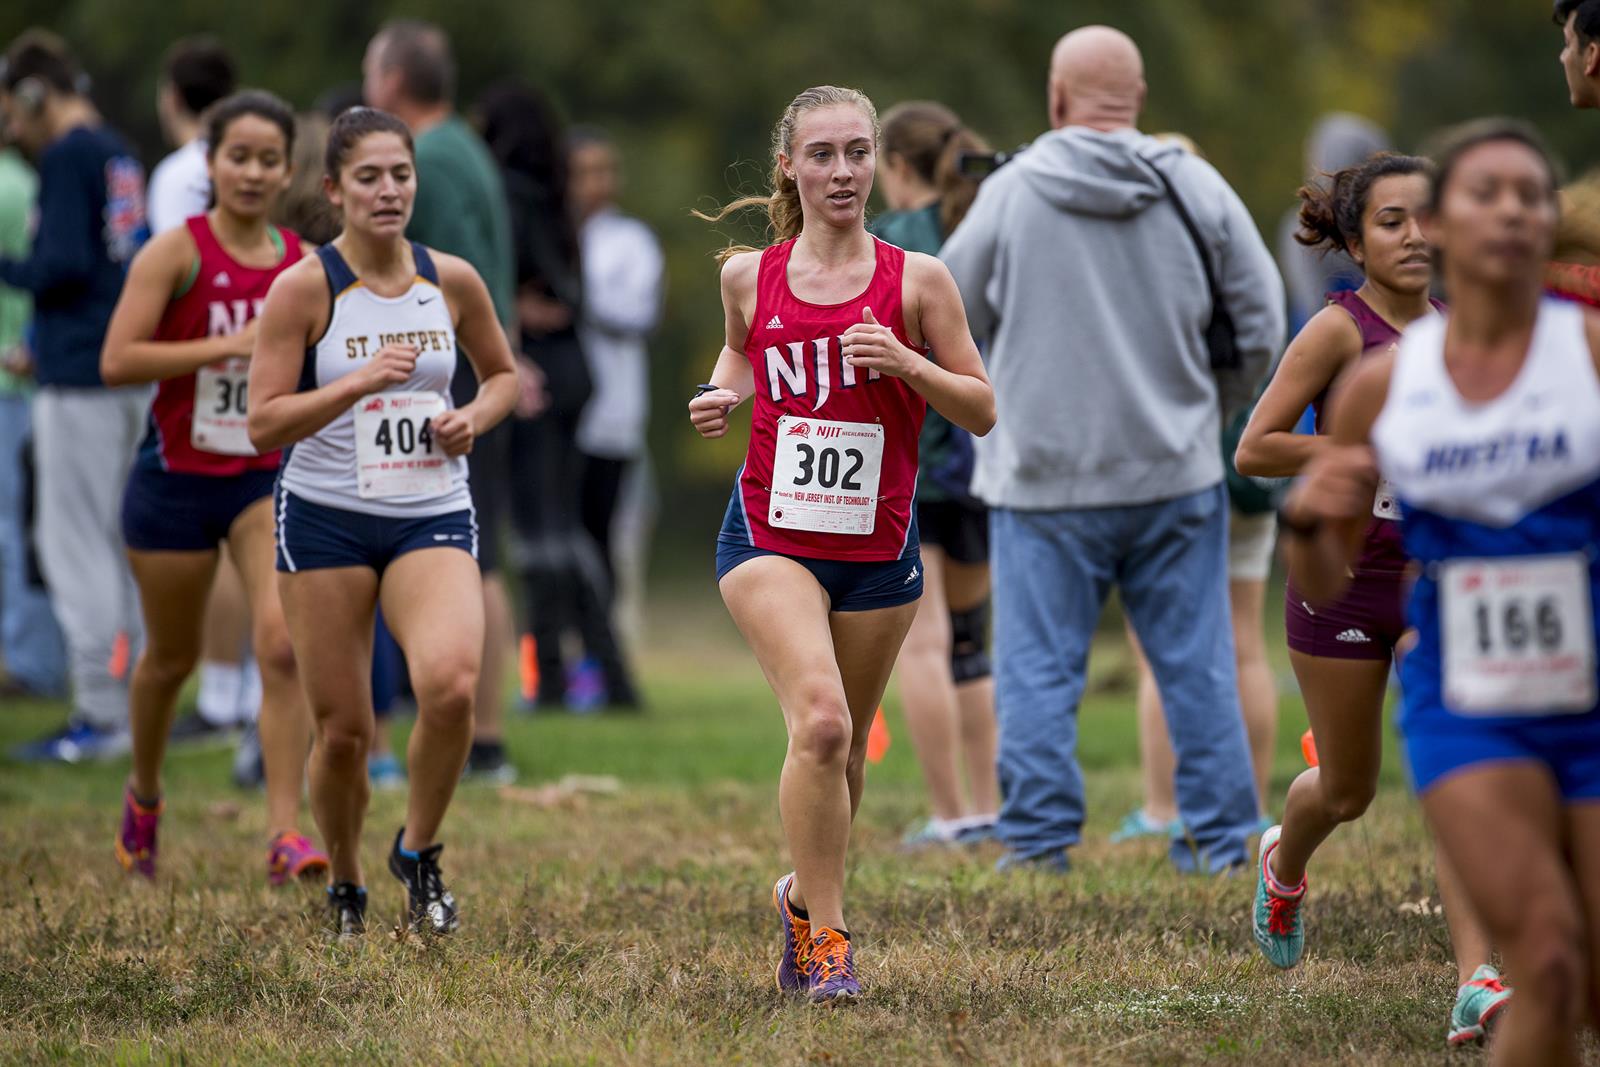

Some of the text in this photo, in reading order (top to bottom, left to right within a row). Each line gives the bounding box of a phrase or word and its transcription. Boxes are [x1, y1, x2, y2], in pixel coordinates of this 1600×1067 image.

[374, 416, 433, 456] 404
[816, 425, 843, 440] NJIT
[793, 443, 864, 491] 302
[794, 491, 805, 501] NEW
[805, 493, 823, 503] JERSEY
[823, 495, 835, 504] INST.
[836, 496, 843, 505] OF
[844, 496, 871, 506] TECHNOLOGY
